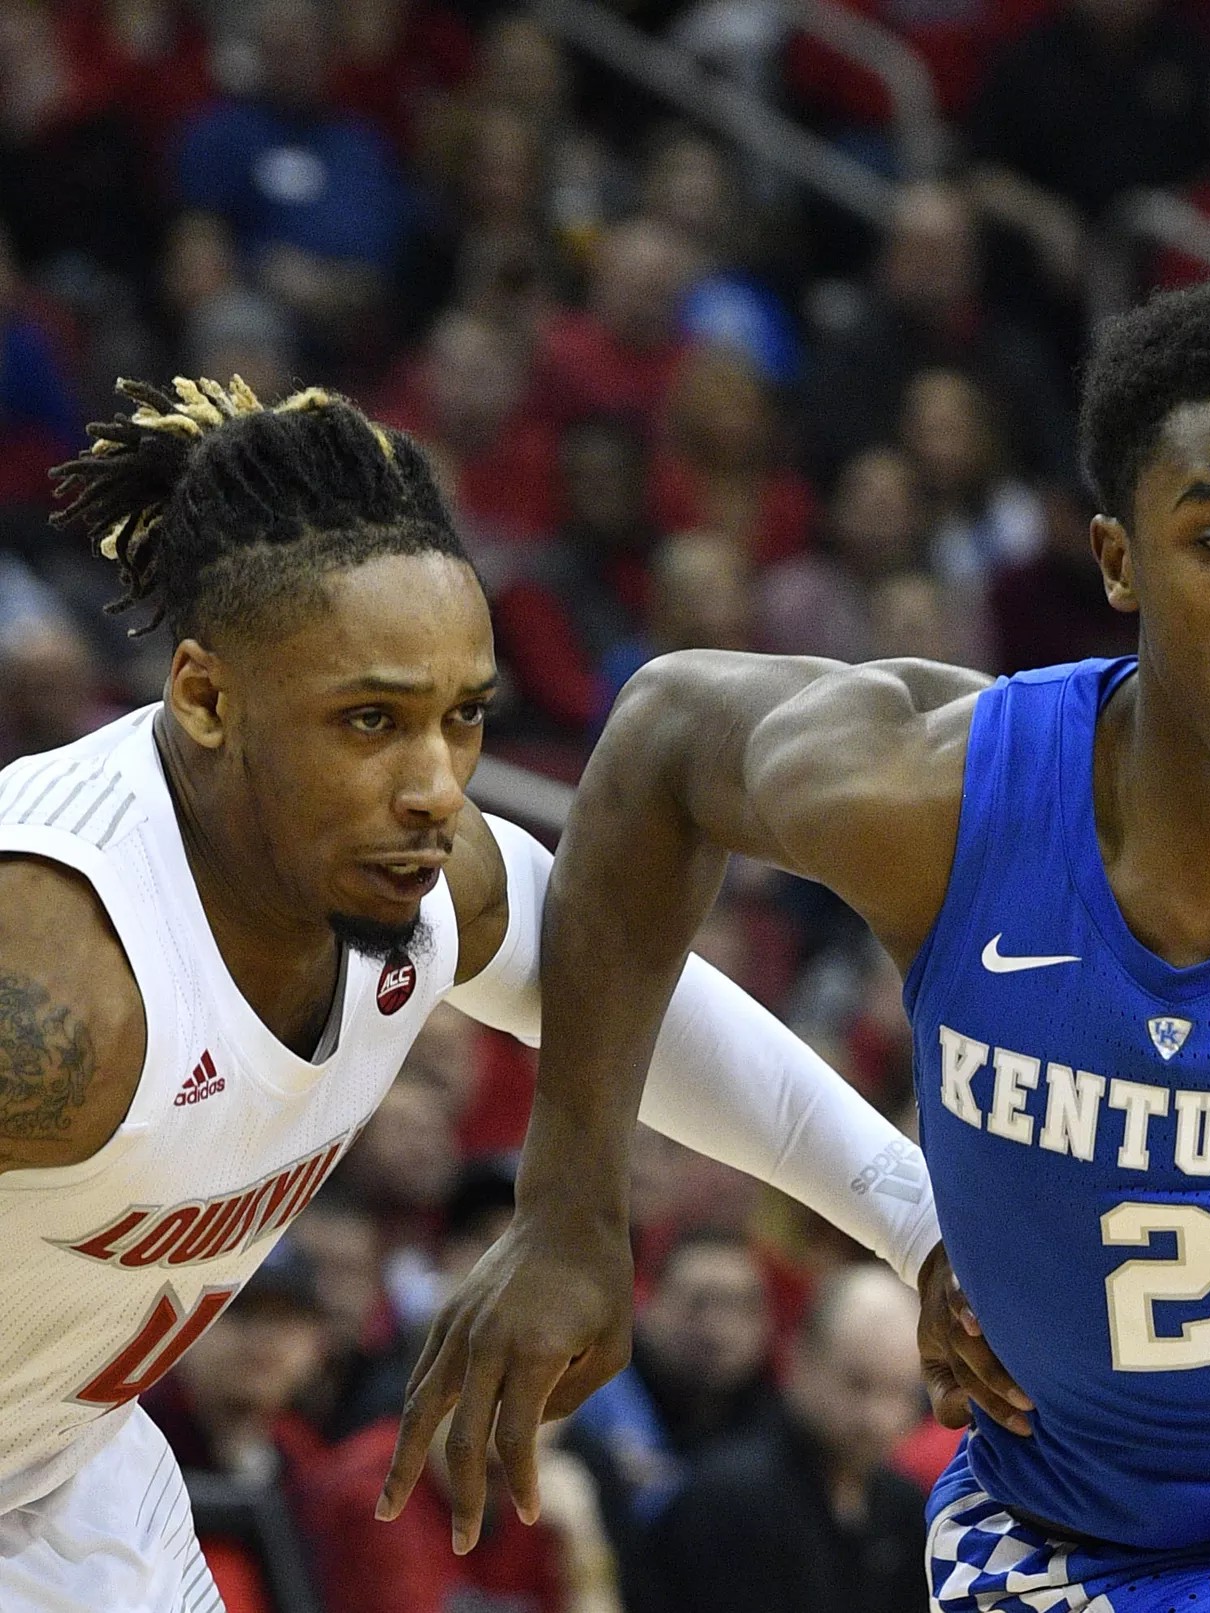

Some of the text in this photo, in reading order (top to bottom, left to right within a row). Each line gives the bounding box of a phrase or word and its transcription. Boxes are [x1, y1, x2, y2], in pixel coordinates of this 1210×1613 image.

[378, 965, 413, 998] ACC
[1155, 1021, 1179, 1045] UK
[173, 1077, 225, 1107] adidas
[850, 1138, 914, 1196] didas
